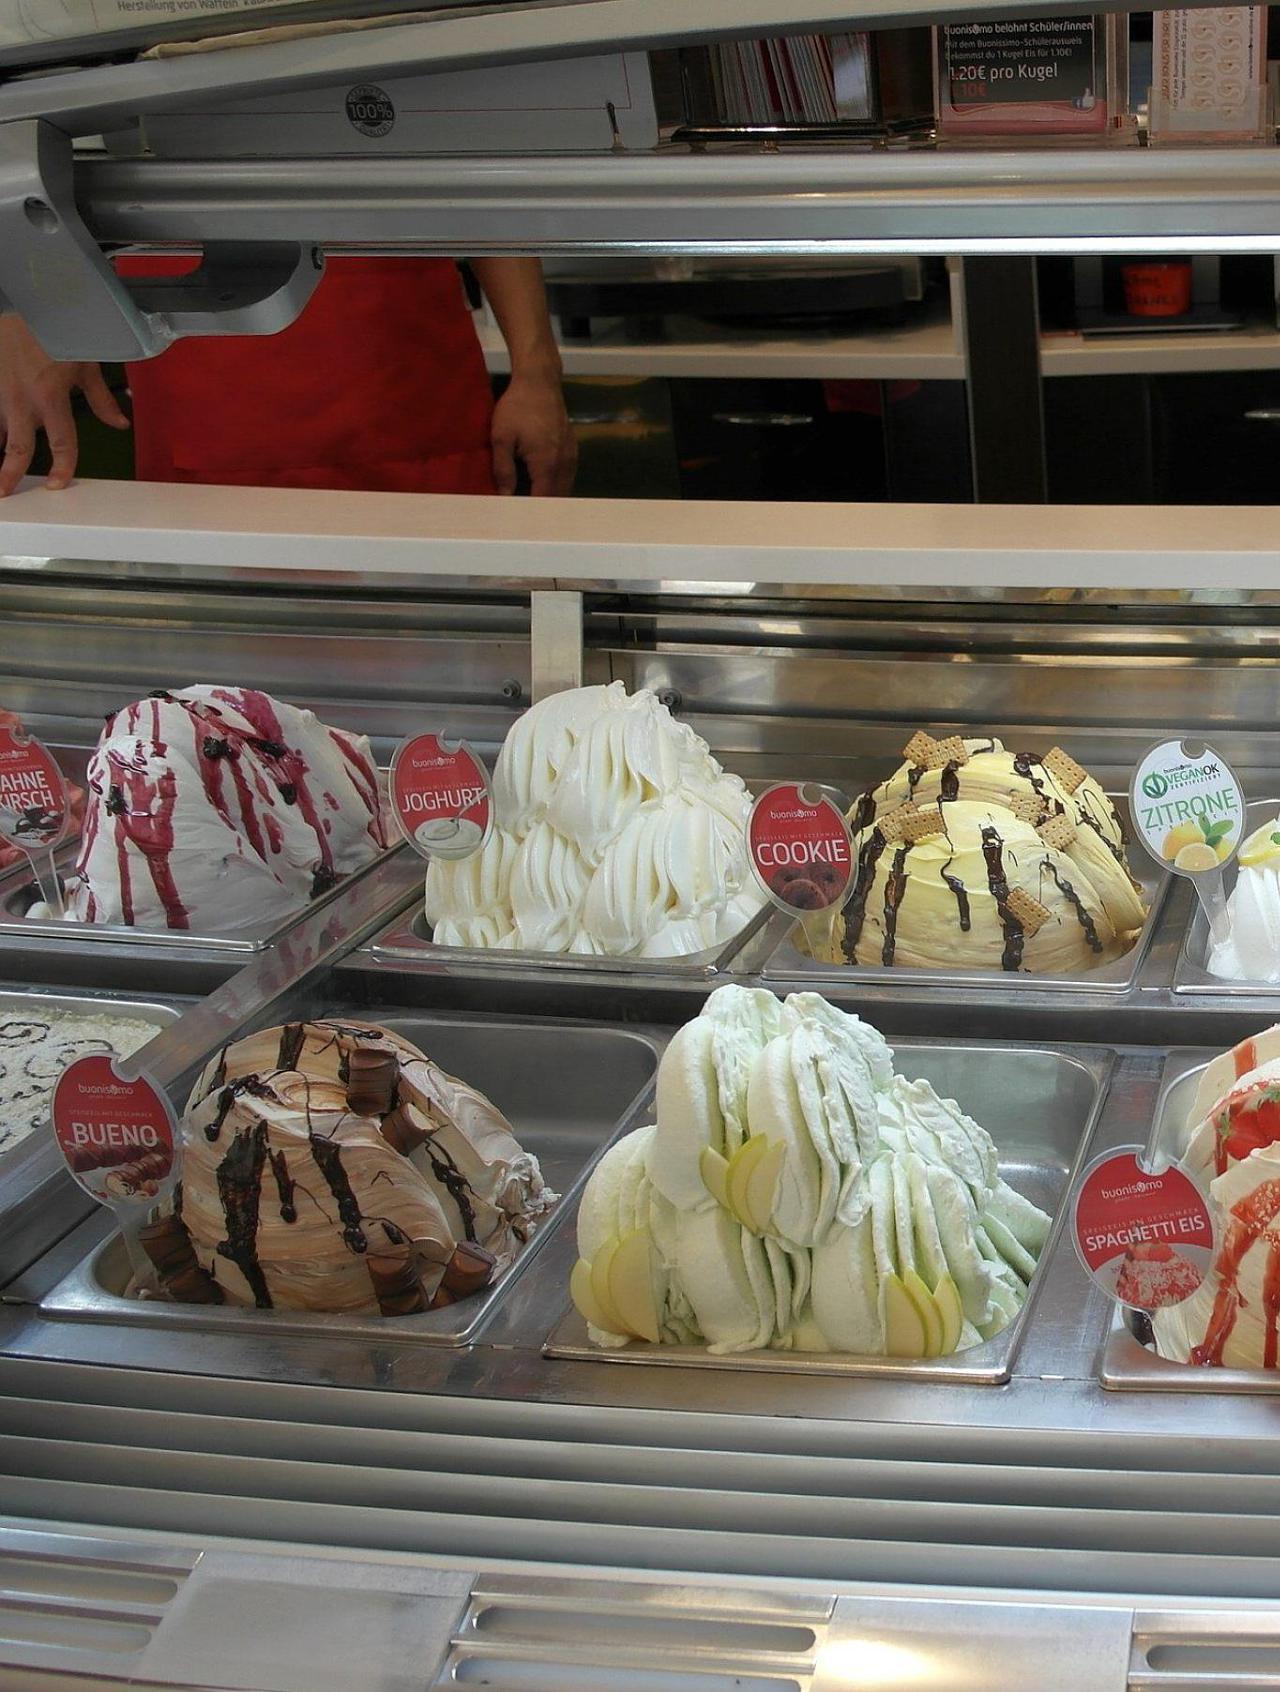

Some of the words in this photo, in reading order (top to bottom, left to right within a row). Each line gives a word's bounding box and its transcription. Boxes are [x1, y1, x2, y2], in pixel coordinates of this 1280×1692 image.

[179, 0, 197, 10] von
[995, 22, 1027, 33] belohnt
[1029, 21, 1093, 33] Schüler/innen
[950, 65, 987, 80] 1.20€
[990, 67, 1014, 82] pro
[1018, 62, 1058, 81] Kugel
[349, 103, 393, 120] 100%
[0, 770, 48, 792] AHNE
[402, 787, 482, 813] JOGHURT
[1140, 788, 1238, 829] ZITRONE
[757, 840, 848, 866] COOKIE
[71, 1122, 158, 1147] BUENO
[1086, 1220, 1177, 1252] SPAGHETTI
[1180, 1215, 1205, 1233] EIS
